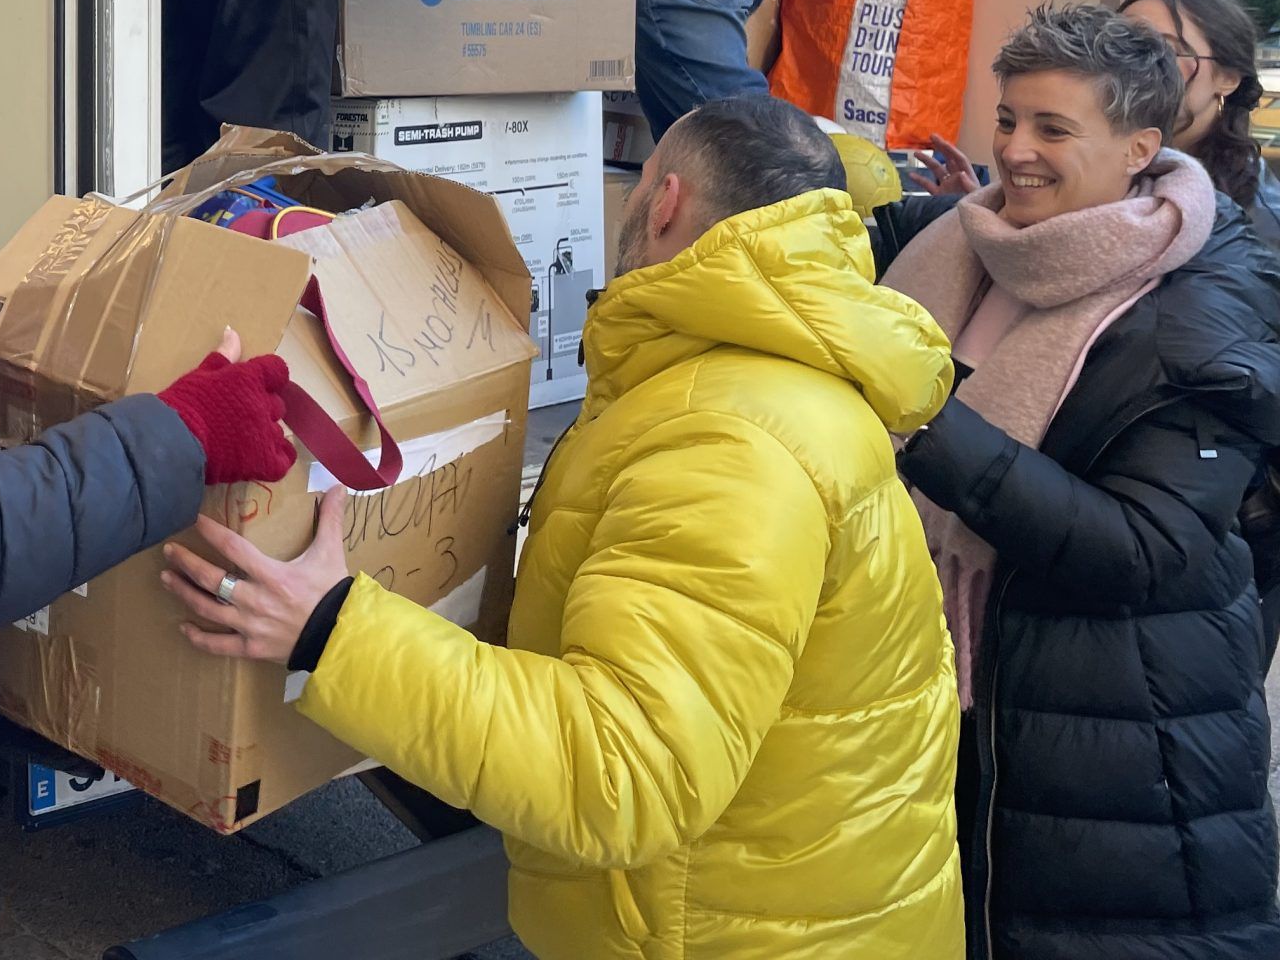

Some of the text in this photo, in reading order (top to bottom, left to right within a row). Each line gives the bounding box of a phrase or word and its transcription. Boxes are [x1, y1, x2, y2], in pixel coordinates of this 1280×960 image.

[860, 3, 905, 30] PLUS
[461, 21, 542, 38] TUMBLING CAR 24 (ES)
[854, 27, 900, 54] D'UN
[852, 51, 894, 77] TOUR
[336, 113, 369, 122] FORESTAL
[844, 99, 886, 125] Sacs
[398, 125, 480, 142] SEMI-TRASH PUMP
[37, 780, 49, 798] E
